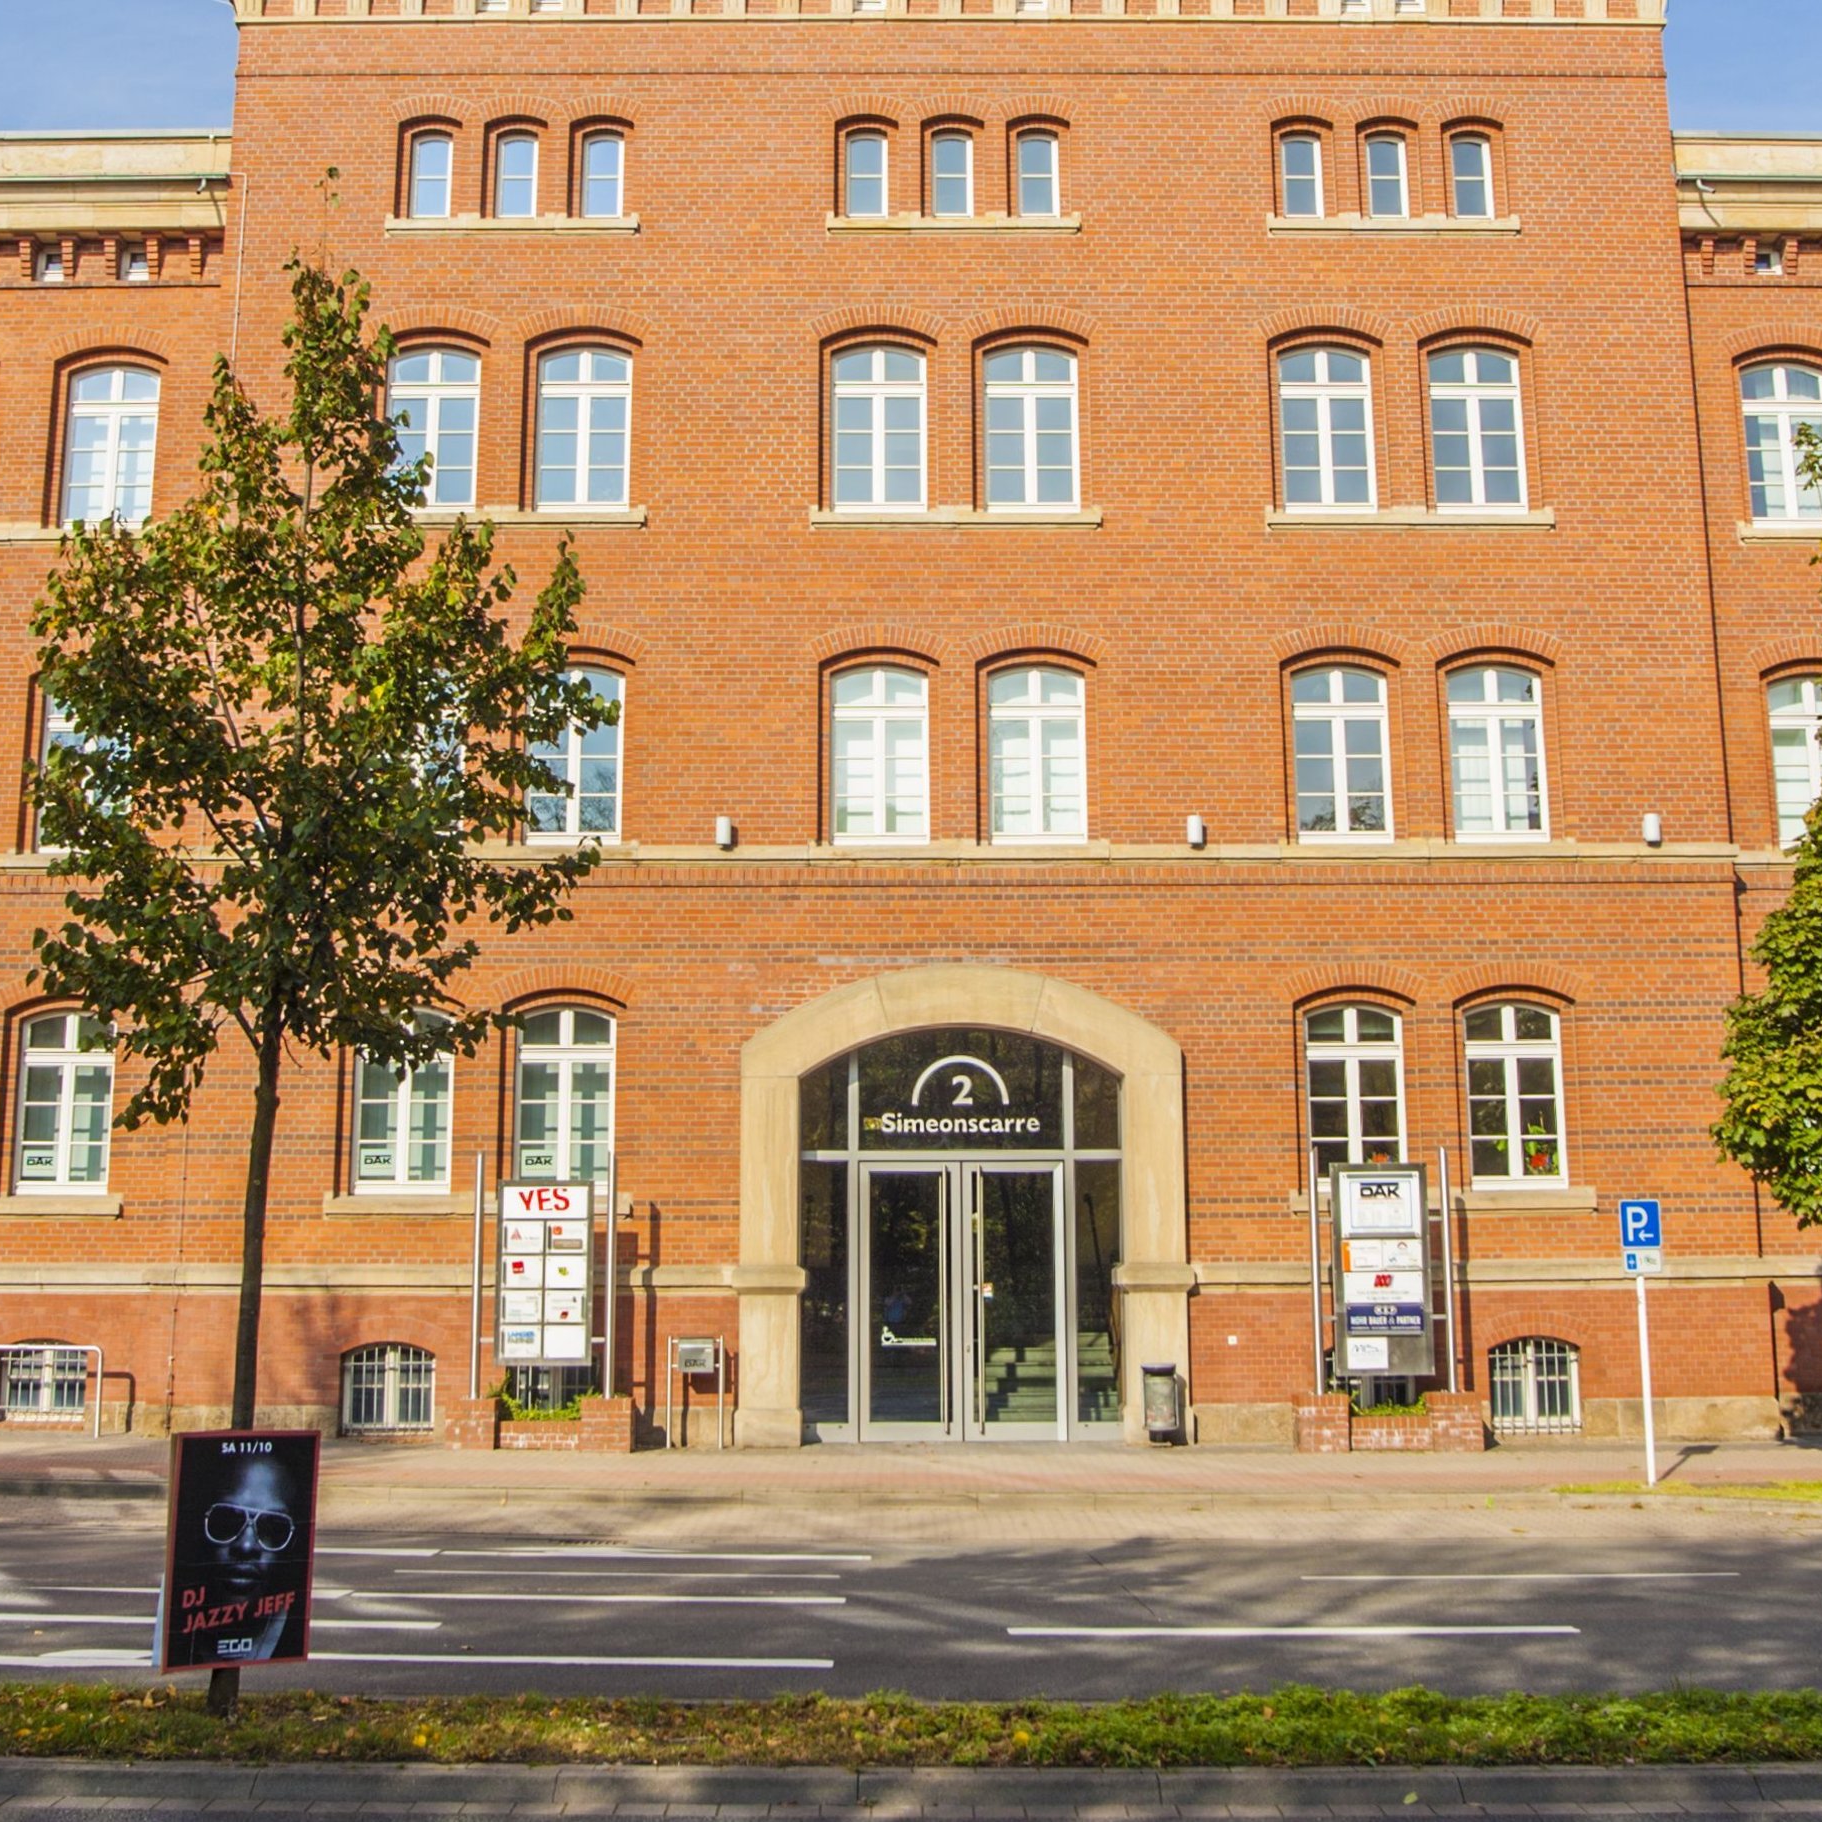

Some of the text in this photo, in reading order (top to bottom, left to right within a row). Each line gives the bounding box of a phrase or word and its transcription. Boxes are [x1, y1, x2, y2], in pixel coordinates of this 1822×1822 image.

[951, 1074, 973, 1106] 2
[881, 1112, 1041, 1134] Simeonscarre
[26, 1156, 54, 1166] DAK
[364, 1154, 392, 1165] DAK
[525, 1155, 553, 1166] DAK
[518, 1187, 570, 1211] YES
[1359, 1182, 1401, 1198] DAK
[1626, 1206, 1648, 1242] P
[221, 1440, 273, 1454] SA 11/10
[182, 1586, 206, 1609] DJ
[183, 1591, 296, 1634] JAZZY JEFF
[217, 1638, 253, 1654] EGO
